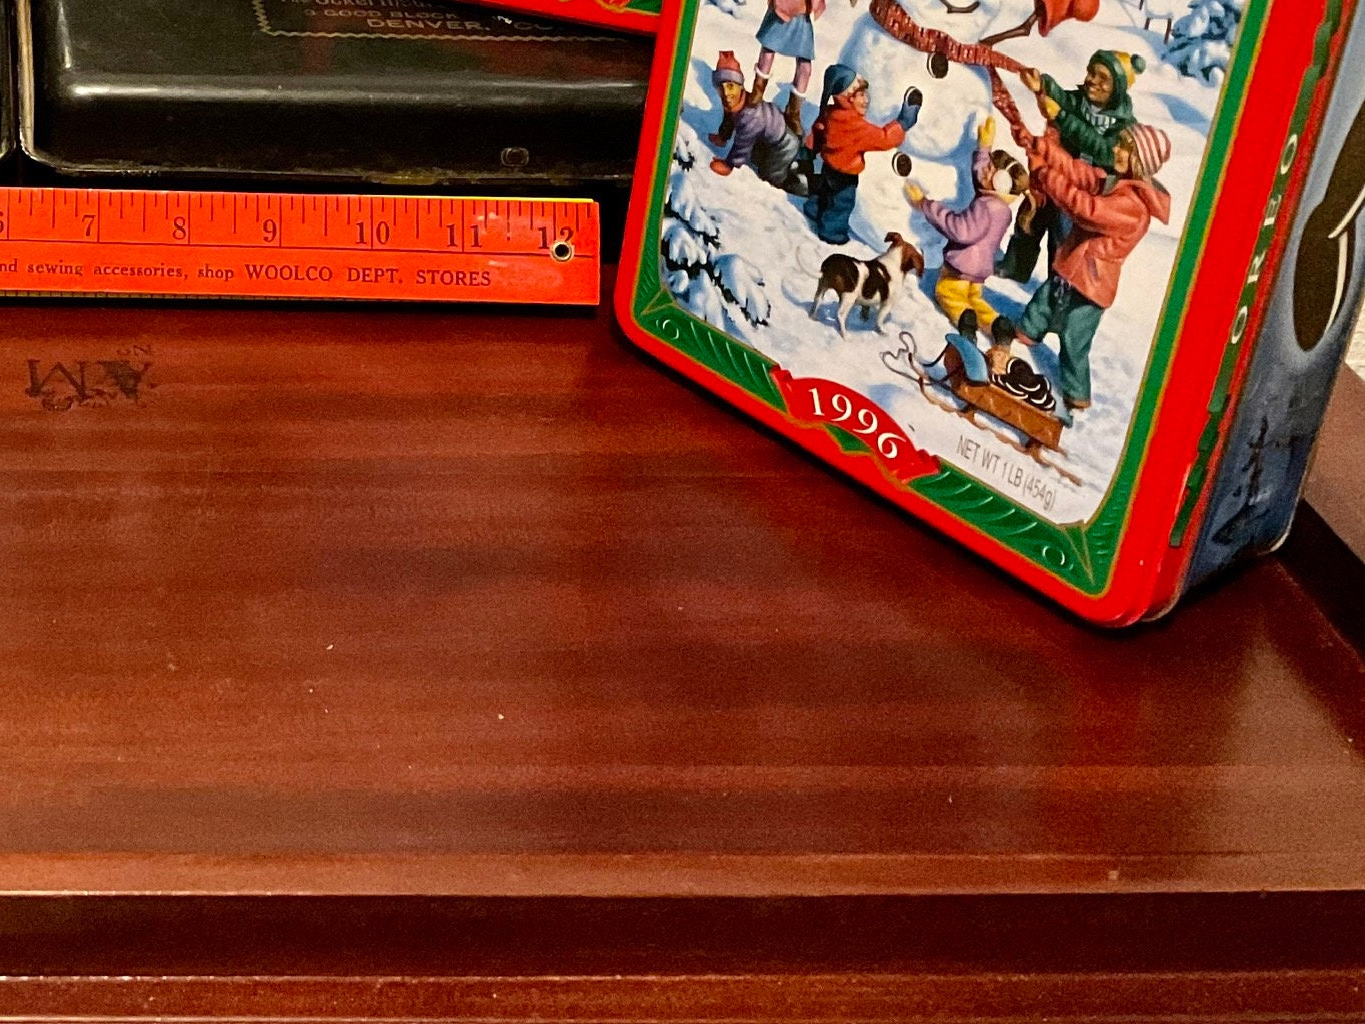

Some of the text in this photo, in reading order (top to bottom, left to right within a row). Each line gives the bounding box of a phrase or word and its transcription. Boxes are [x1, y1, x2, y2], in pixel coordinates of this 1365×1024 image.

[81, 213, 97, 238] 7
[171, 216, 187, 241] 8
[263, 218, 278, 243] 9
[355, 221, 390, 245] 10
[446, 224, 484, 248] 11
[537, 226, 575, 250] 12
[1231, 134, 1298, 344] OREO
[27, 260, 84, 277] sewing
[93, 262, 188, 281] accessories,
[197, 264, 234, 281] shop
[244, 264, 333, 282] WOOLCO
[346, 267, 404, 285] DEPT.
[415, 270, 492, 287] STORES
[808, 386, 907, 460] 1996
[956, 435, 1057, 512] NET WT 1 LB (454g)
